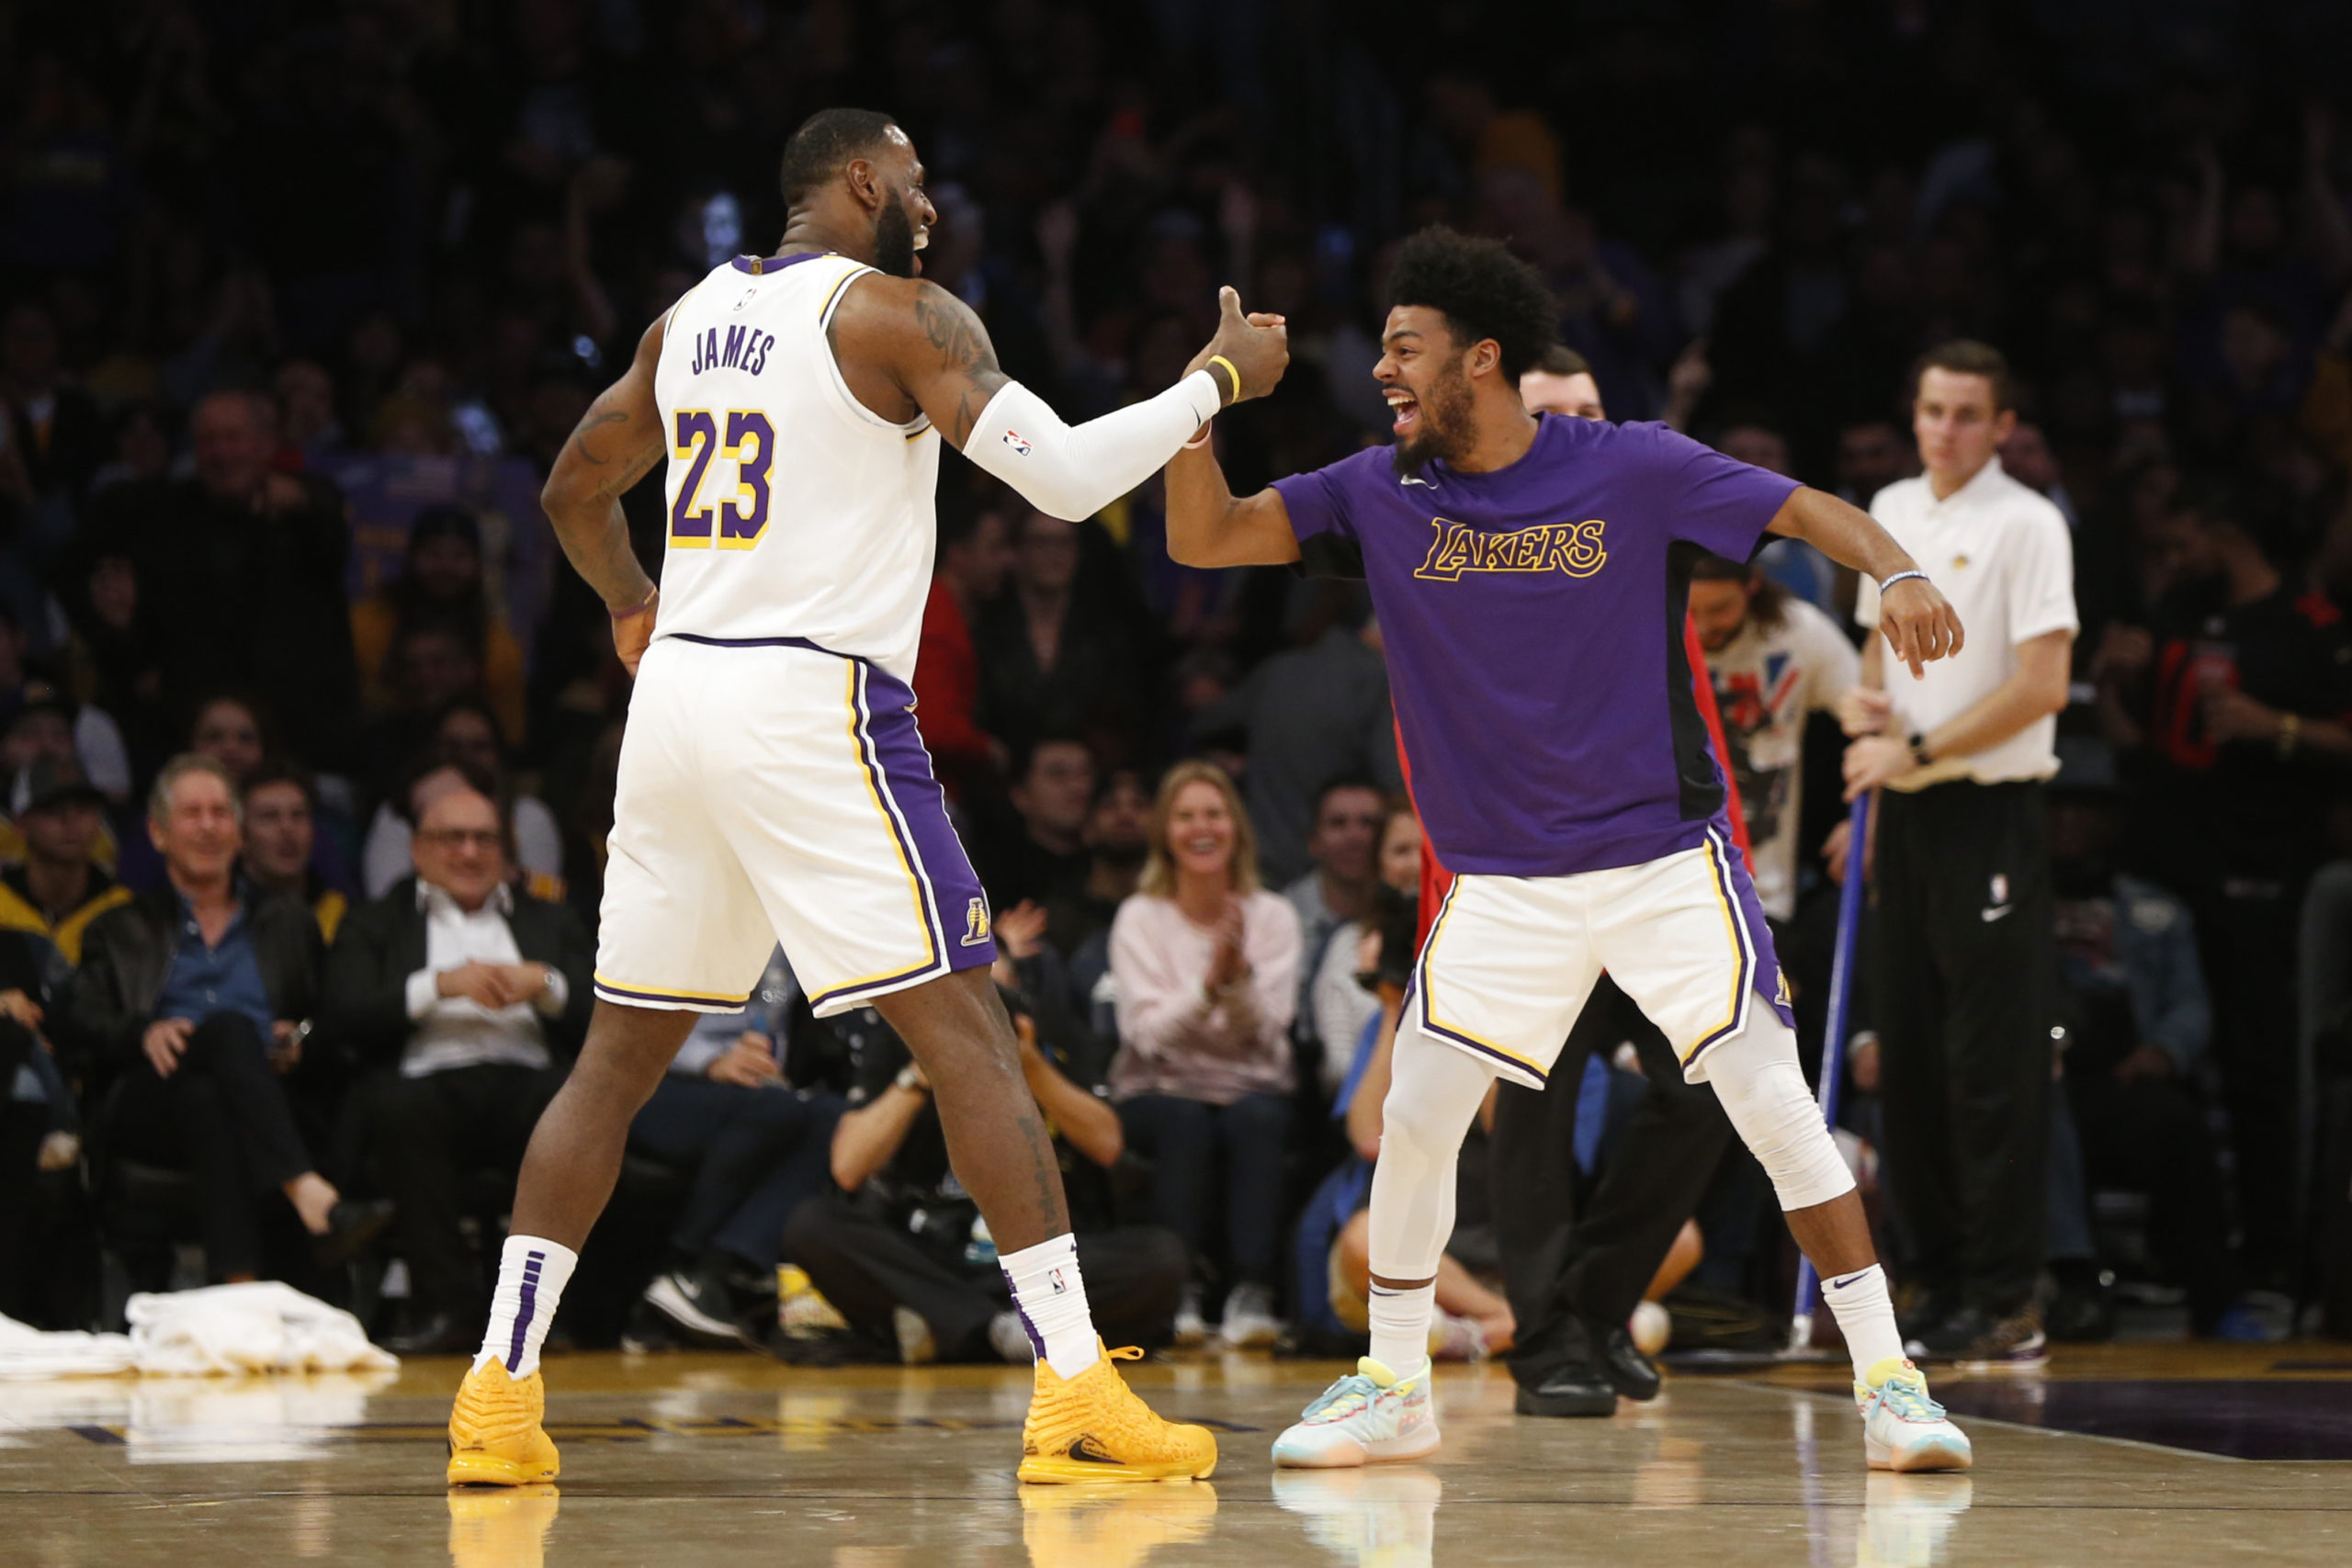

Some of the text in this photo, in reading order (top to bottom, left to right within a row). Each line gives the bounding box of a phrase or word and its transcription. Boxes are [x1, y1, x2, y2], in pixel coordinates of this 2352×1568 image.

[691, 324, 775, 377] JAMES
[668, 408, 778, 551] 23
[1413, 516, 1608, 581] LAKERS
